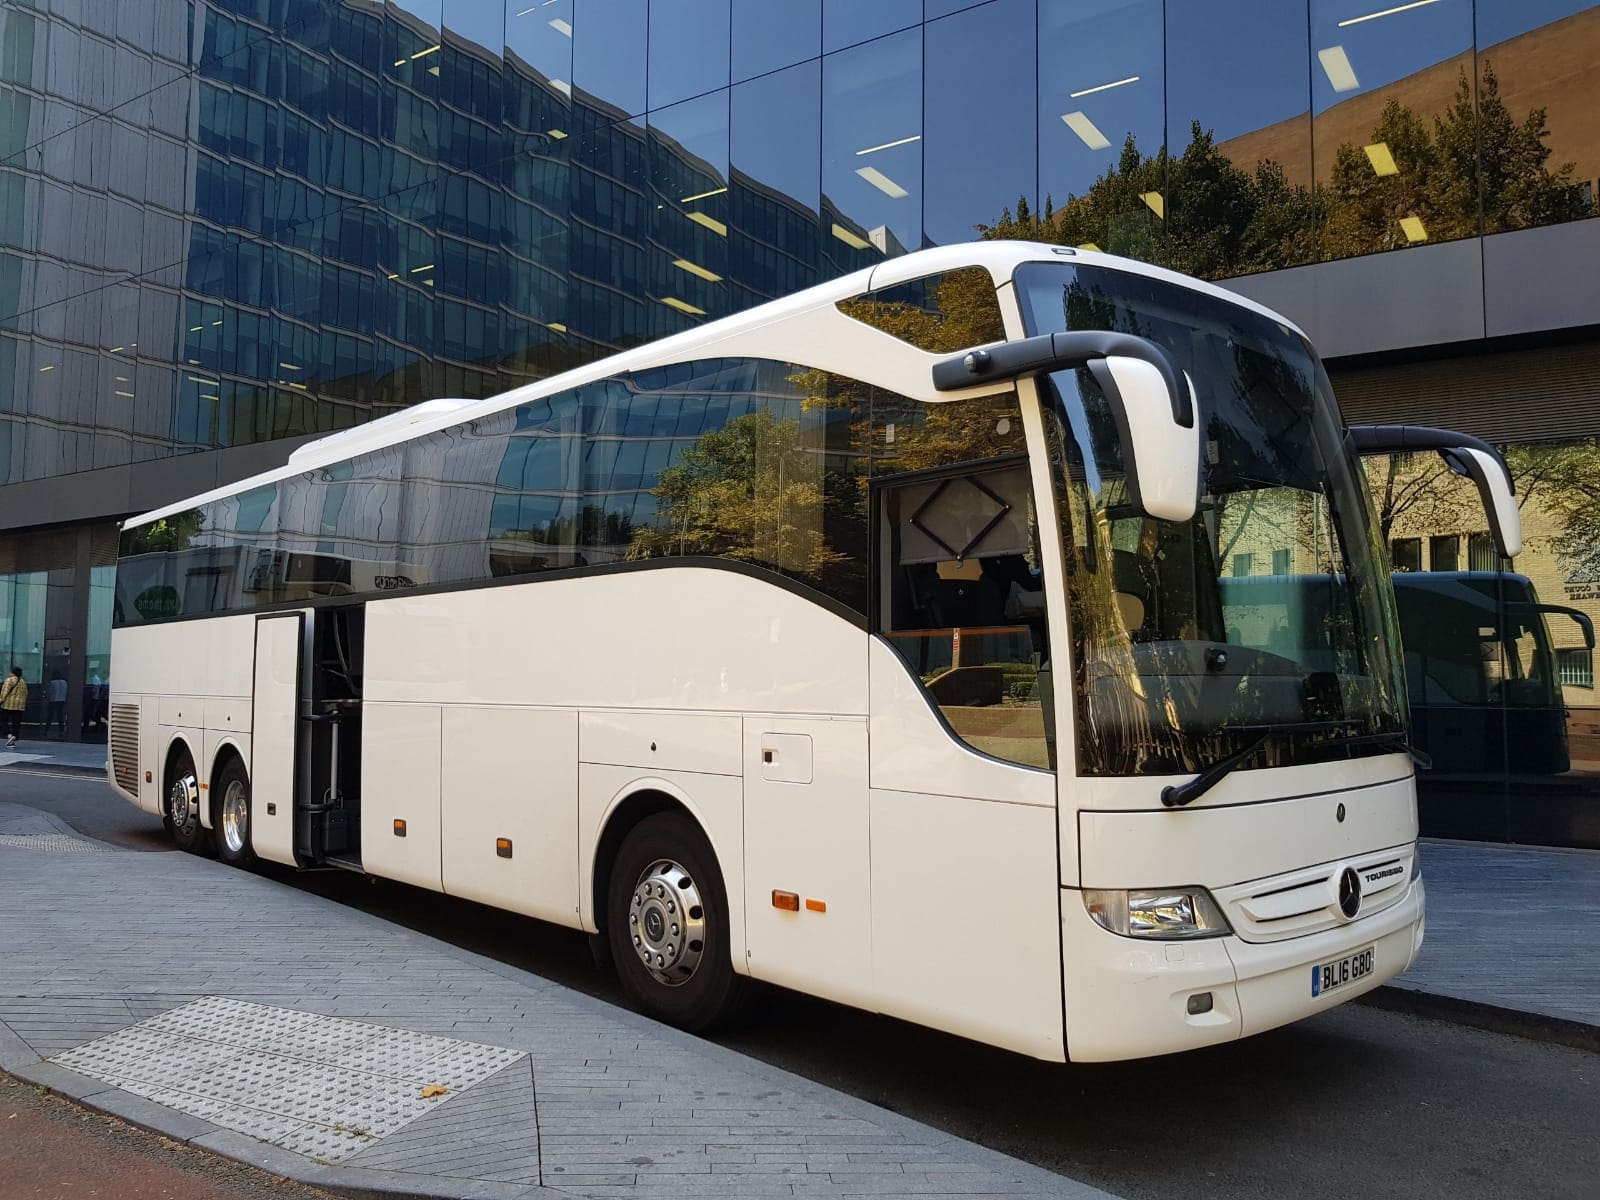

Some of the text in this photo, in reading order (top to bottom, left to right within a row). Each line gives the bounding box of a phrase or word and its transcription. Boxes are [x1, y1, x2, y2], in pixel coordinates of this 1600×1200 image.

[1365, 866, 1403, 882] TOURISMO
[1323, 951, 1371, 989] BL16 GBO
